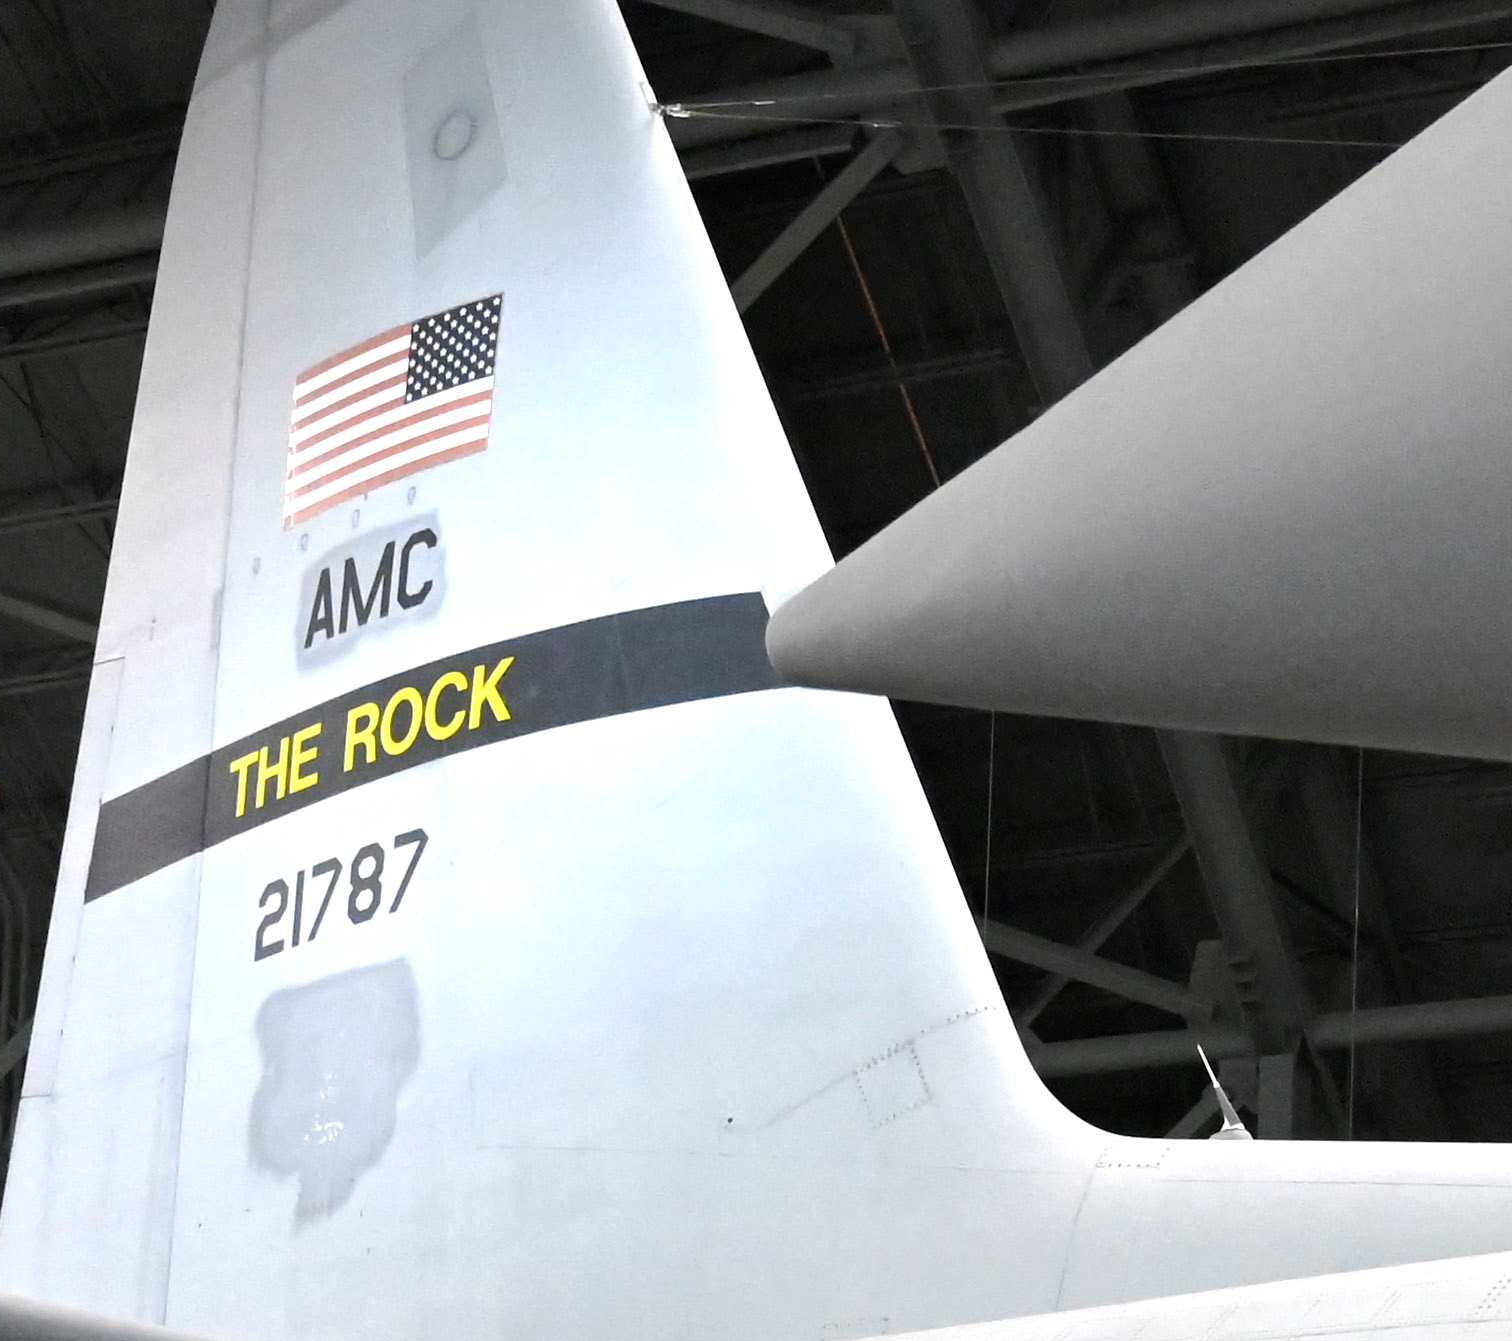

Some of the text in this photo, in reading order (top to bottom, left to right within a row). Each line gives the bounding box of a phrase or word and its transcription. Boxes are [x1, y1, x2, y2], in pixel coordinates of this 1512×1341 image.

[304, 528, 439, 649] AMC
[229, 657, 515, 817] THE ROCK
[254, 829, 429, 962] 21787
